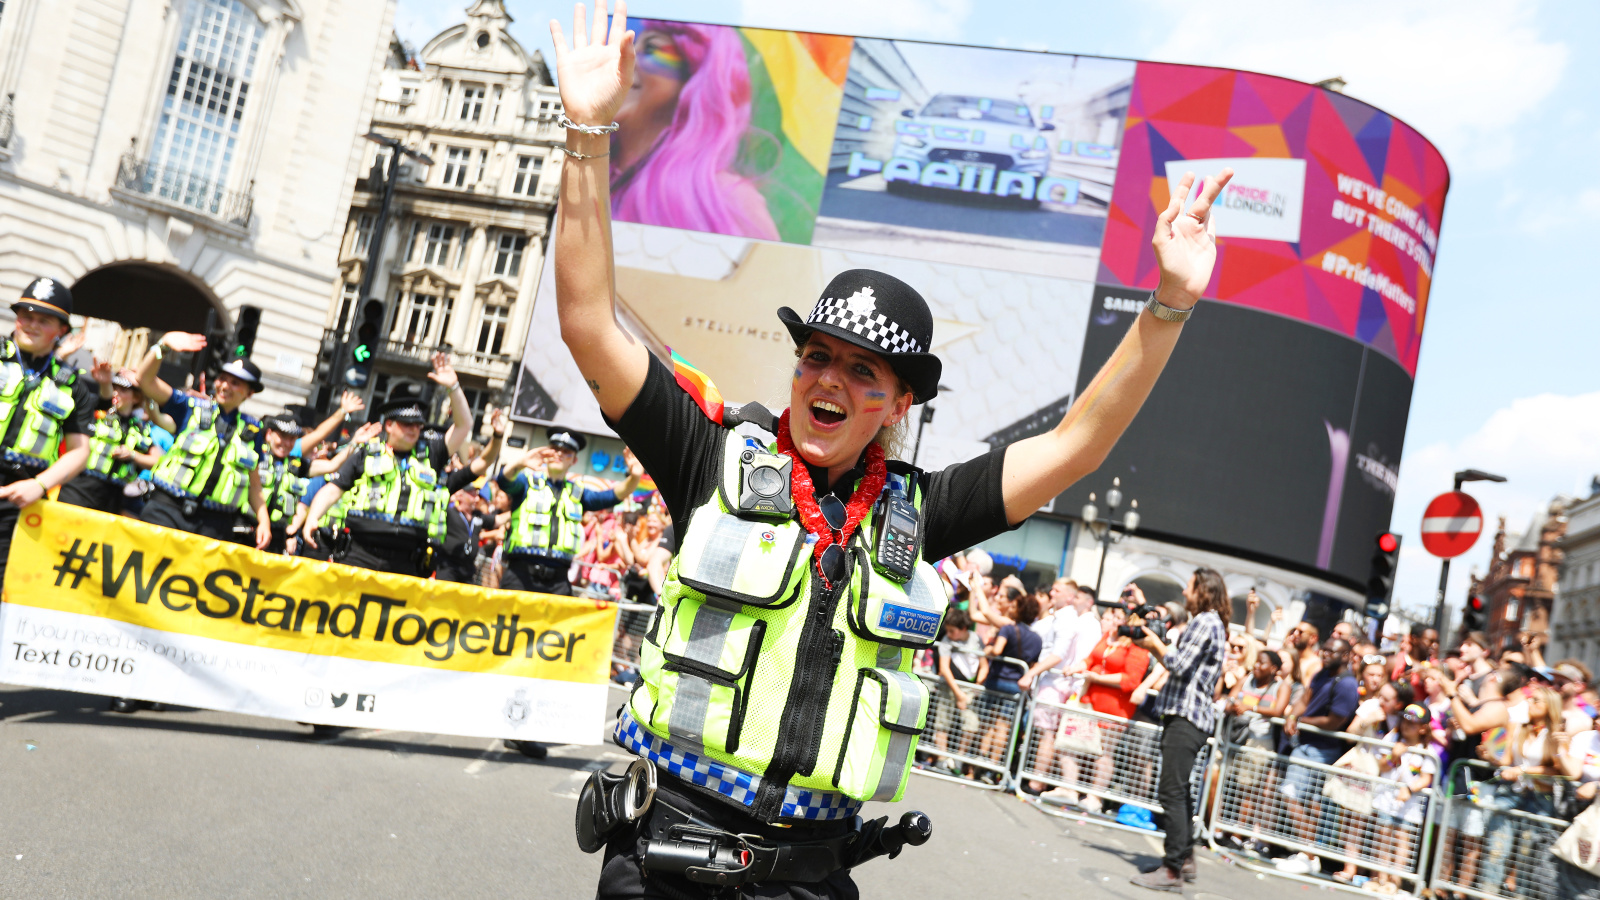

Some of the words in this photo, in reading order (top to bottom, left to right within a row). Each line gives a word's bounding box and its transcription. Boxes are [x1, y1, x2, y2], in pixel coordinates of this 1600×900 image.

[1225, 196, 1284, 217] LONDON
[1227, 184, 1270, 201] PRIDE
[1272, 193, 1286, 204] IN
[1337, 173, 1387, 210] WE'VE
[1386, 196, 1420, 231] COME
[1332, 199, 1367, 227] BUT
[1367, 213, 1417, 256] THERE'S
[1322, 251, 1416, 315] #PrideMatters
[1103, 296, 1147, 313] SAMS
[53, 538, 586, 663] #WeStandTogether
[900, 610, 917, 618] BRITISH
[916, 613, 939, 622] TRANSPORT
[896, 616, 937, 634] POLICE
[13, 641, 61, 666] Text
[68, 649, 136, 675] 61016
[17, 616, 27, 635] If
[32, 623, 68, 641] you
[73, 628, 122, 648] need
[126, 637, 148, 652] us
[153, 643, 177, 659] on
[179, 648, 219, 667] your
[222, 655, 279, 676] journey
